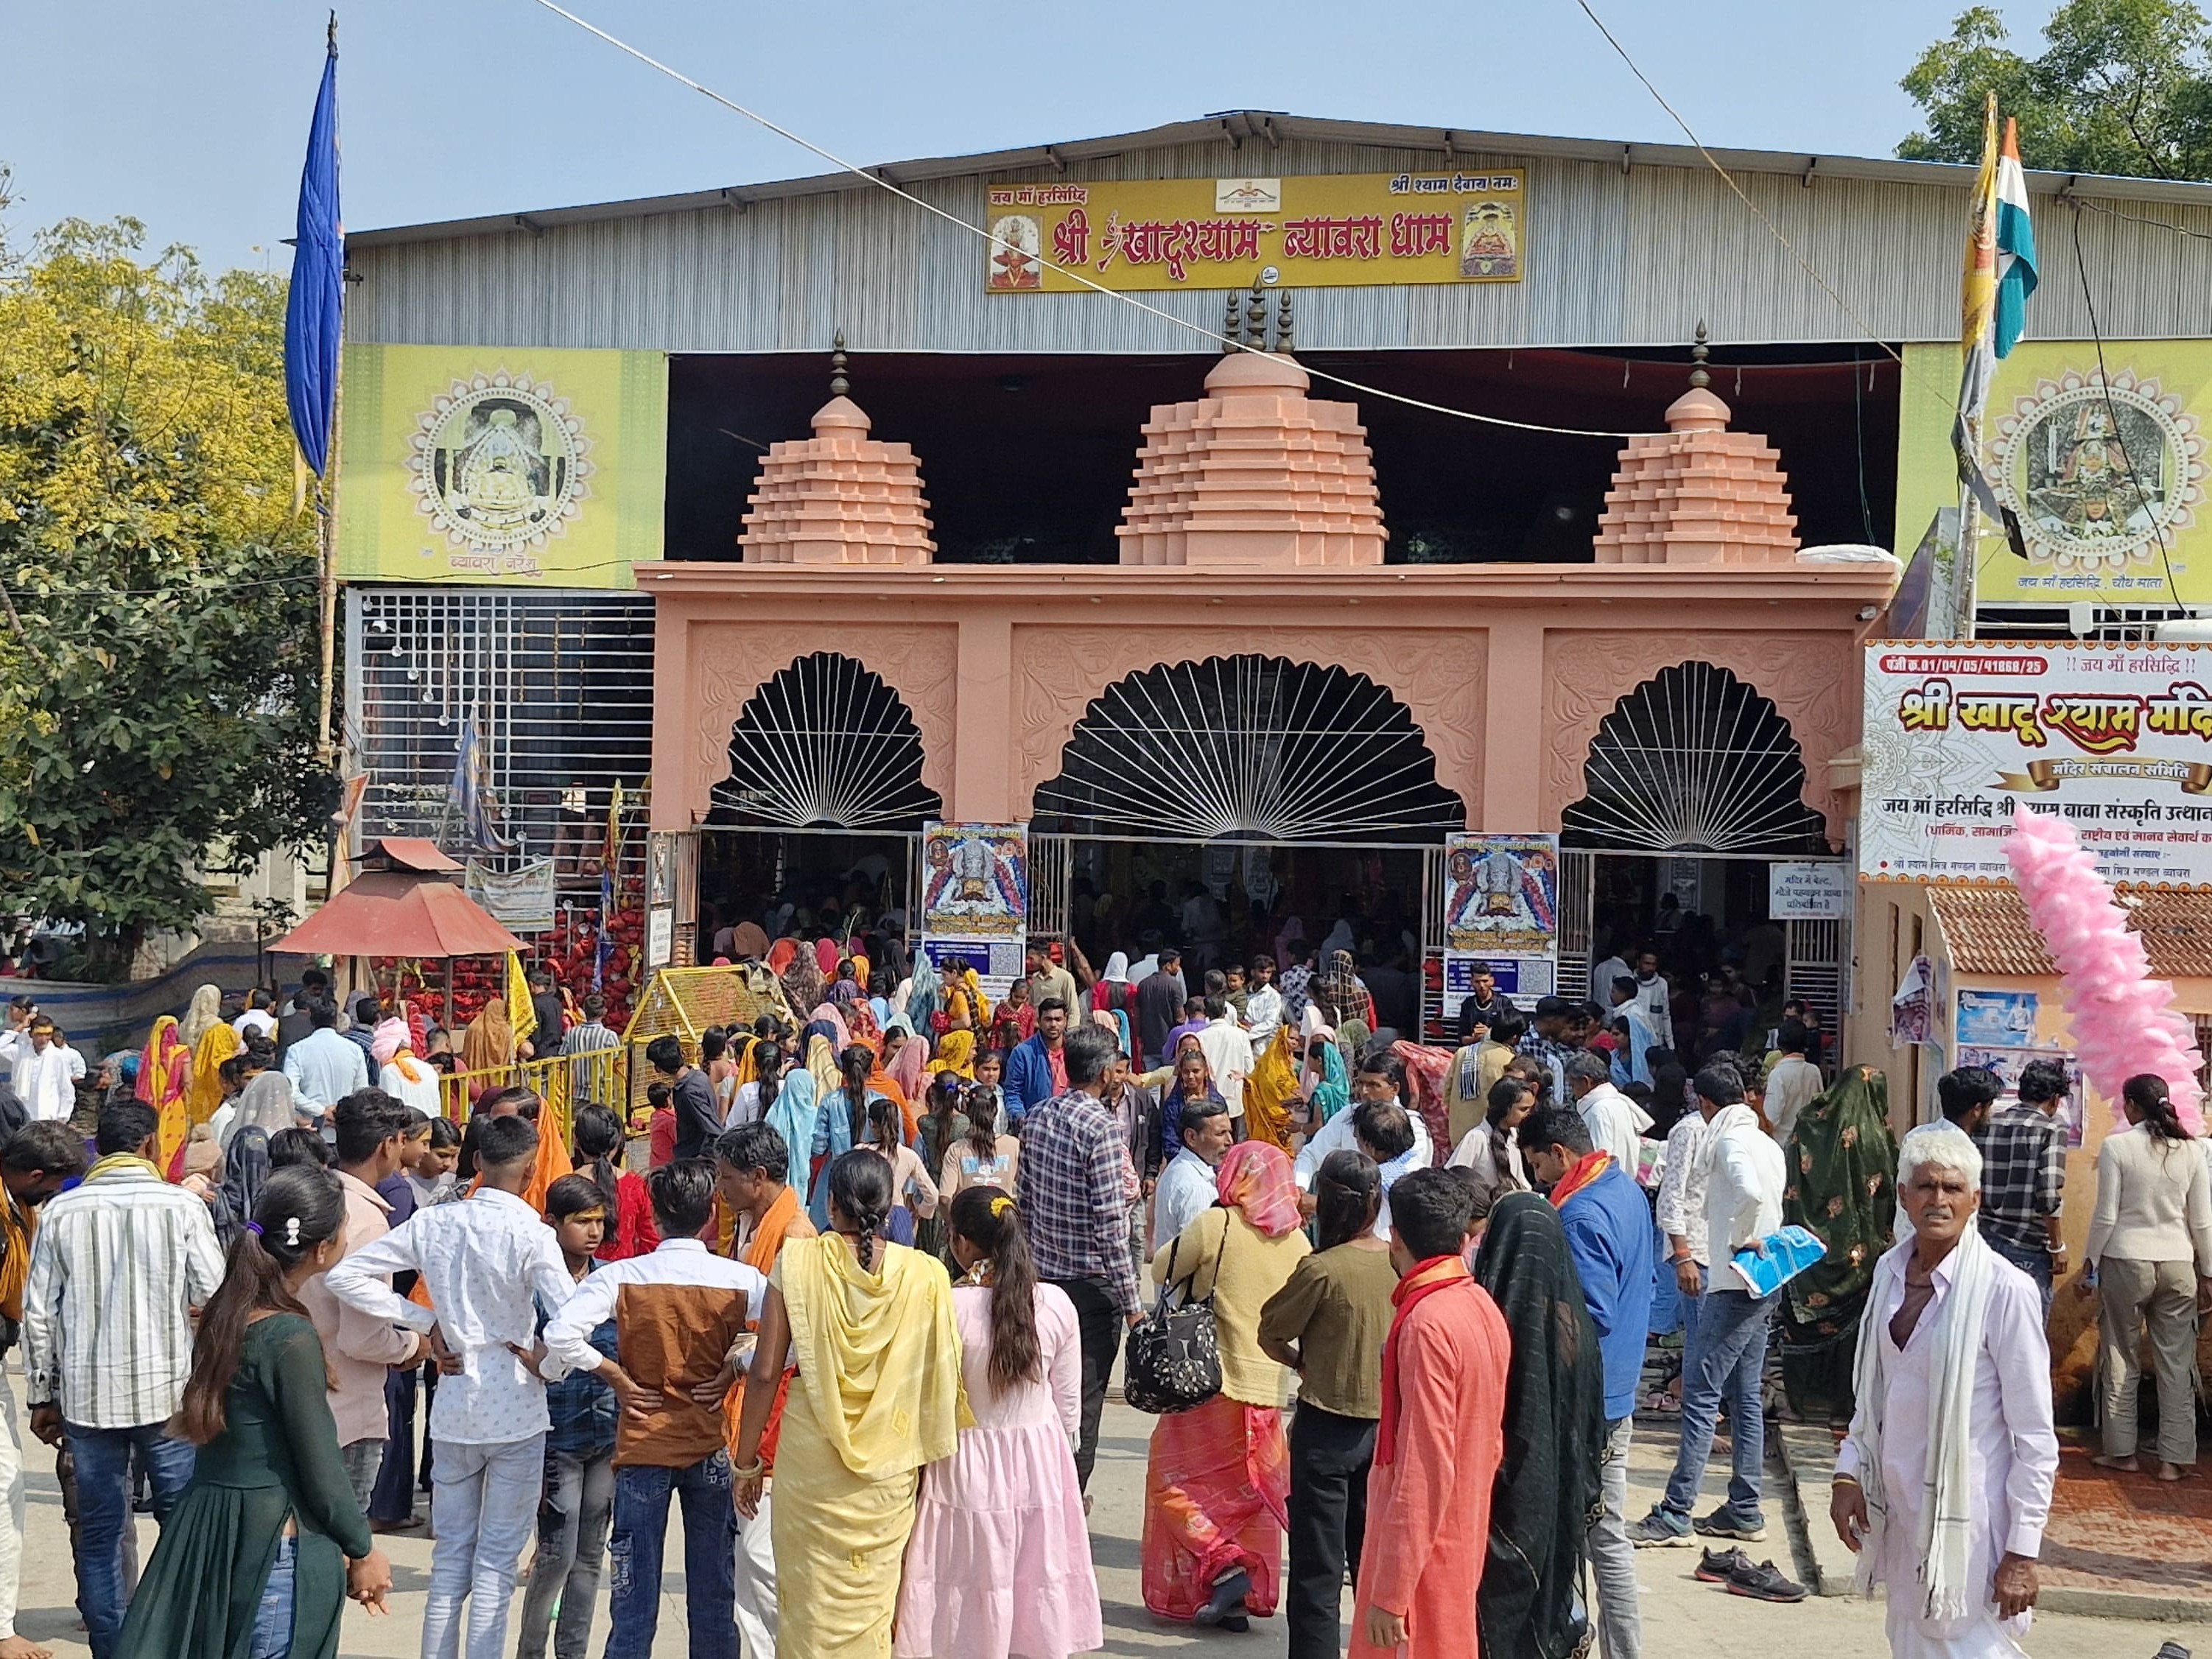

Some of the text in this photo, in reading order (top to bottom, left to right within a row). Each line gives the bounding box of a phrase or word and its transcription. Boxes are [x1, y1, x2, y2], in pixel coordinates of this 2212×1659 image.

[1390, 173, 1410, 194] श्री
[1414, 178, 1449, 193] श्याम
[991, 192, 1013, 204] जय
[1053, 207, 1091, 264] श्री
[1390, 211, 1453, 256] धाम
[2018, 577, 2038, 587] जय
[2136, 578, 2163, 588] माता
[2081, 659, 2103, 672] जय
[2107, 653, 2125, 673] माँ
[1898, 678, 1952, 732] श्री
[1956, 692, 2048, 747] खाटू
[2040, 693, 2143, 754] श्याम
[2051, 760, 2190, 779] मंदिर संचालन समिति
[1882, 799, 1909, 814] जय
[1913, 792, 1931, 815] माँ
[1997, 795, 2015, 816] श्री
[2063, 804, 2101, 818] बाबा
[2104, 798, 2162, 826] संस्कृति
[1971, 824, 2018, 838] सामाजि
[2115, 827, 2130, 841] एवं
[2132, 830, 2164, 842] मानव
[1892, 857, 1904, 869] श्री
